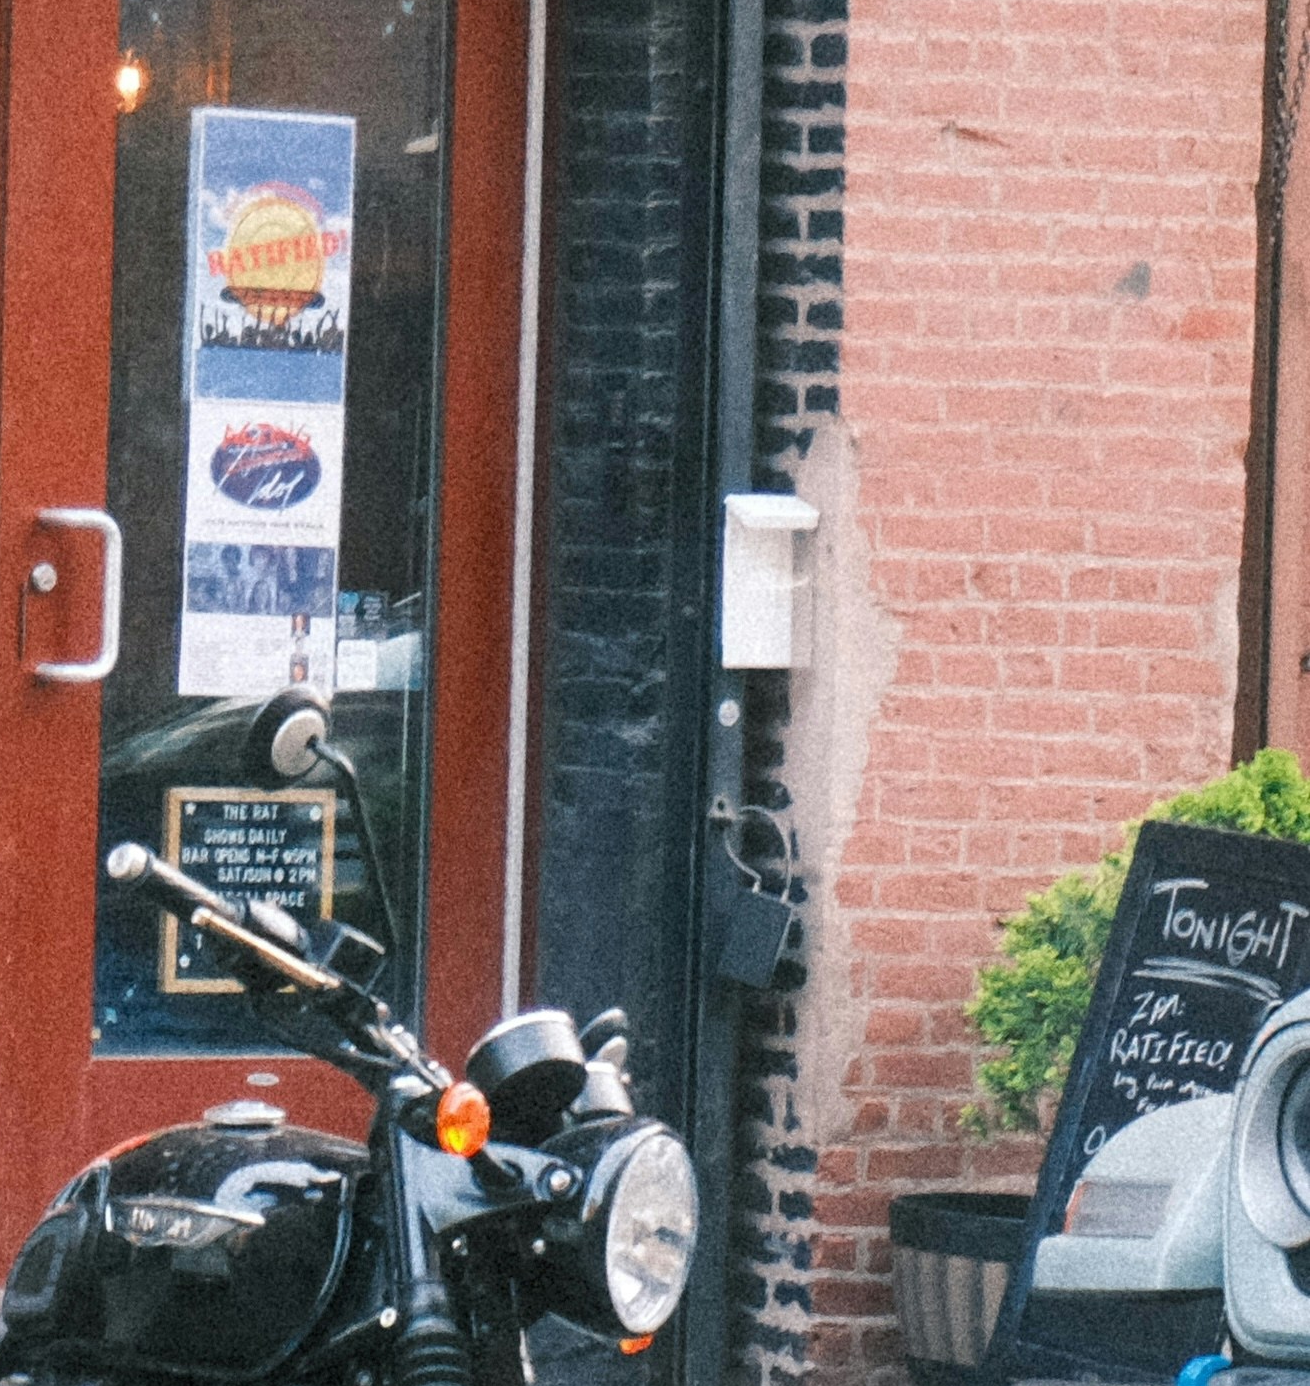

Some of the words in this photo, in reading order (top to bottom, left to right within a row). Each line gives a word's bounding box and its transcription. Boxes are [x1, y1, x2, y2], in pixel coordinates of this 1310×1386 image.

[223, 804, 248, 821] THE
[253, 805, 278, 821] RAT
[204, 827, 246, 845] SHOWS
[248, 828, 287, 845] DAILY
[182, 848, 208, 864] BAR
[214, 848, 250, 864] OPENS
[1153, 878, 1309, 970] TONIGHT
[1108, 1028, 1235, 1073] RATIFIED!
